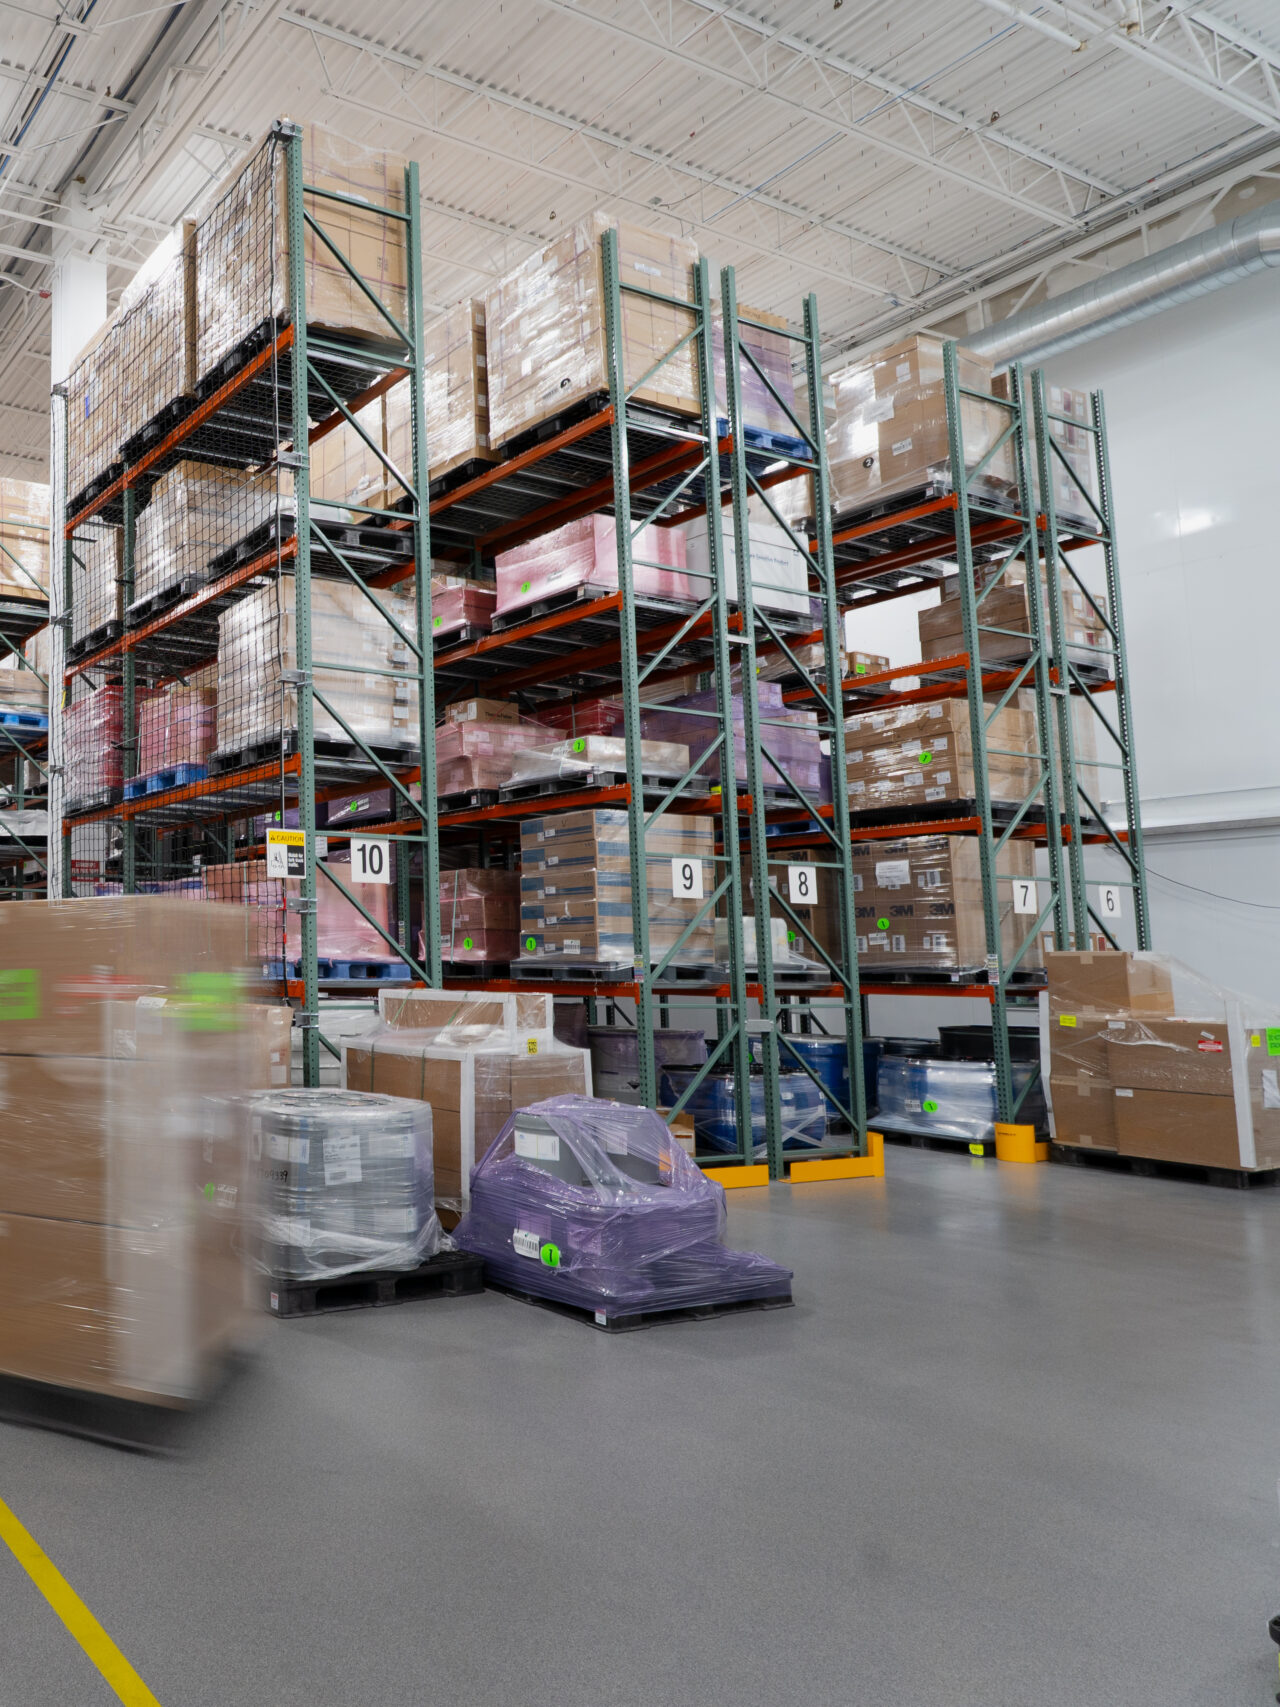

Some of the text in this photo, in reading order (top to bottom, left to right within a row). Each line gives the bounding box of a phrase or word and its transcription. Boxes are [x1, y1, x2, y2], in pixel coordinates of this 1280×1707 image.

[276, 834, 304, 843] CAUTION
[357, 843, 383, 875] 10
[682, 864, 693, 890] 9
[798, 871, 809, 896] 8
[1020, 885, 1028, 907] 7
[1106, 890, 1114, 912] 6
[855, 907, 875, 918] 3M
[889, 904, 914, 917] 3M
[929, 903, 954, 915] 3M
